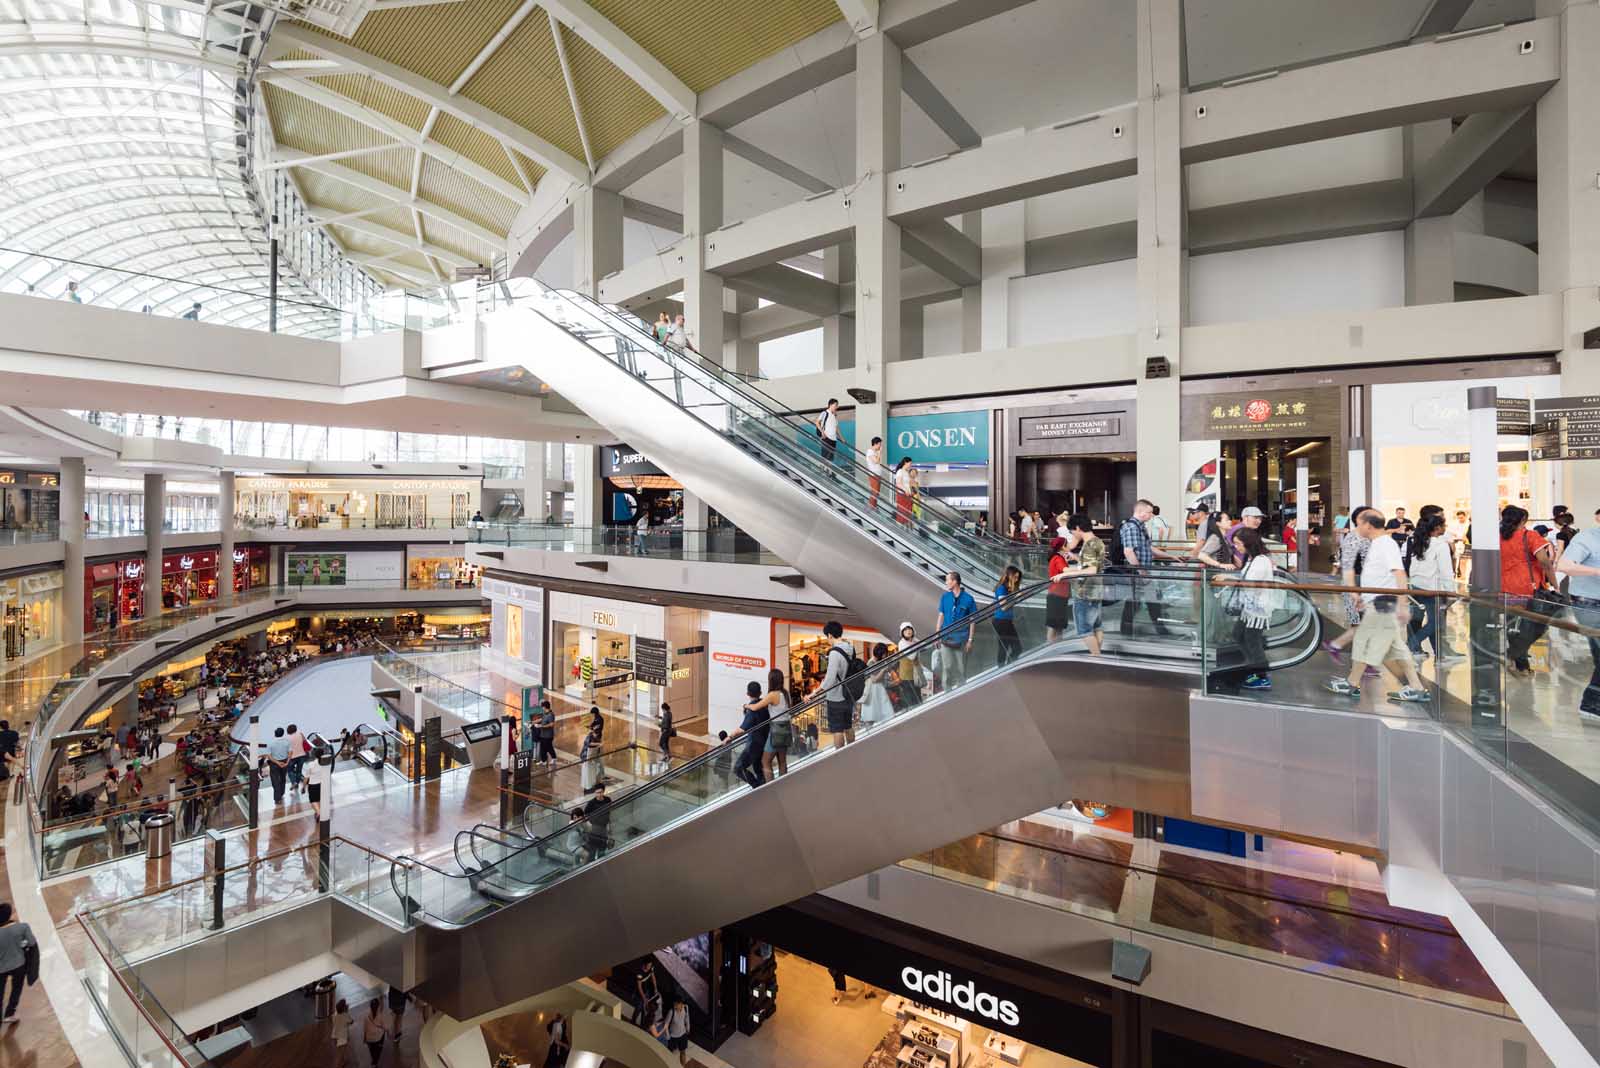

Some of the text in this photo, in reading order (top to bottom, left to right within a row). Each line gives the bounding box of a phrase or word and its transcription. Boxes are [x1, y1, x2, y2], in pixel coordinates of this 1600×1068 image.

[1069, 420, 1107, 429] EXCHANGE
[1067, 427, 1101, 435] CHANGER
[897, 426, 977, 449] ONSEN
[623, 454, 643, 464] SUPER
[593, 610, 617, 628] FENDI
[743, 658, 763, 666] SPORTS
[517, 757, 528, 769] B1
[901, 966, 1020, 1026] adidas
[911, 1031, 938, 1048] YOUR
